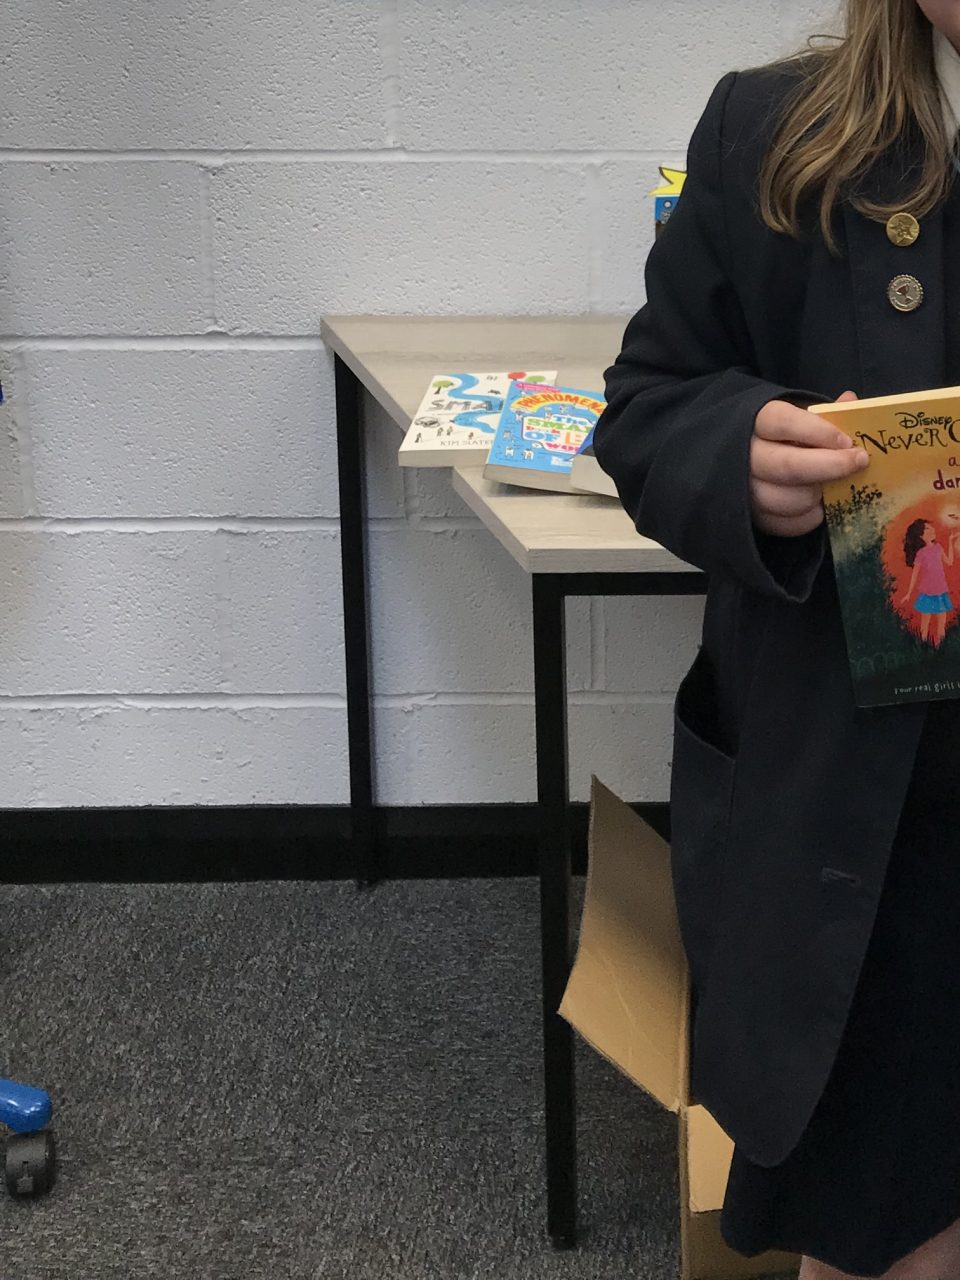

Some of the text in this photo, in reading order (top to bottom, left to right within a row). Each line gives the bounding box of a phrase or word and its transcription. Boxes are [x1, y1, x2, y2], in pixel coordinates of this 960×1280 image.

[430, 399, 504, 413] SMA
[516, 392, 605, 415] PHENOMEN
[462, 439, 494, 447] SLATE
[914, 682, 932, 692] real
